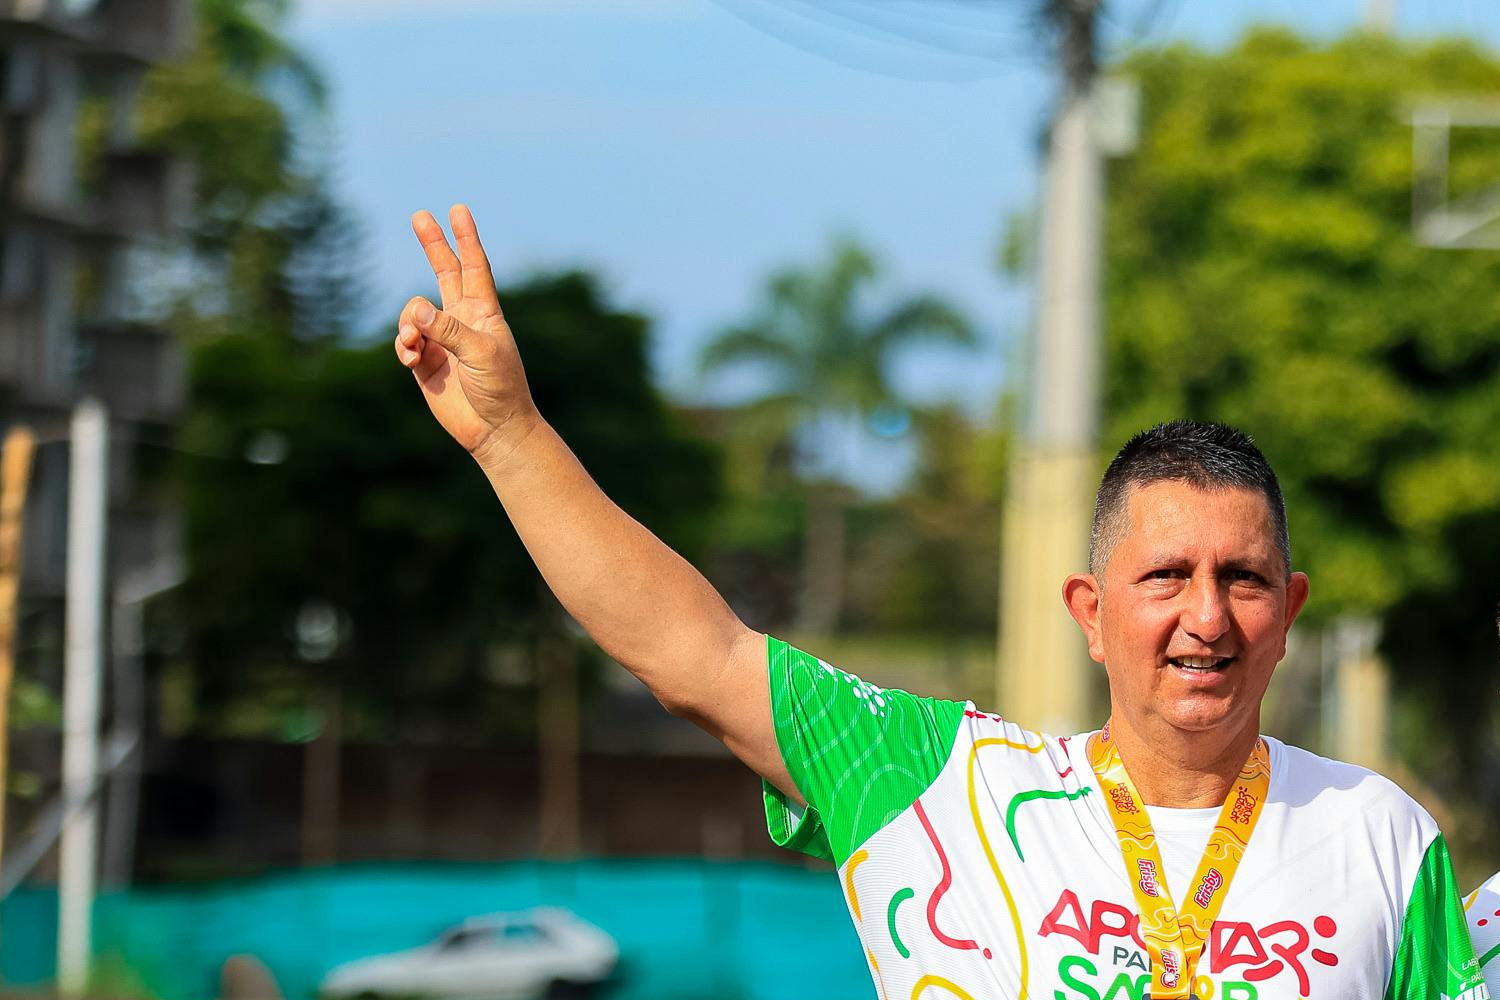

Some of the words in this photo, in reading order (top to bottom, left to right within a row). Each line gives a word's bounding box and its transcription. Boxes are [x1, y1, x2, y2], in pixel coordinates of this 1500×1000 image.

[1137, 858, 1159, 897] Frisby
[1194, 868, 1223, 909] Frisby
[1037, 889, 1310, 997] APTAR
[1112, 946, 1152, 972] PA
[1160, 949, 1179, 988] Frisy
